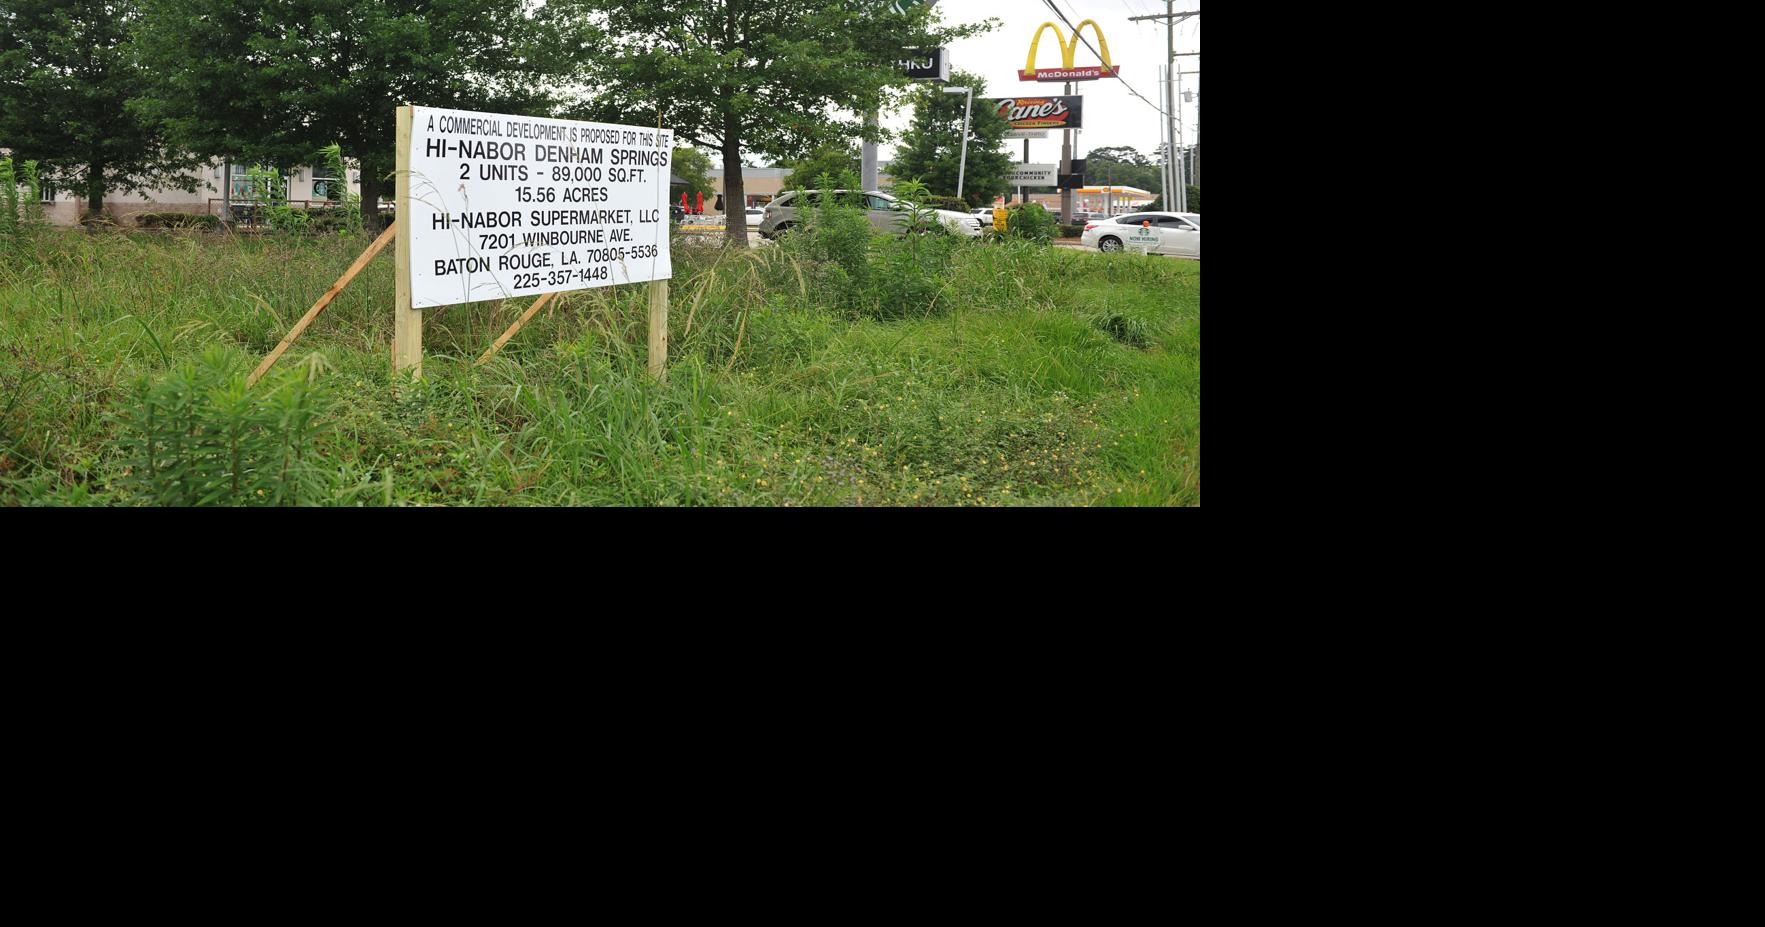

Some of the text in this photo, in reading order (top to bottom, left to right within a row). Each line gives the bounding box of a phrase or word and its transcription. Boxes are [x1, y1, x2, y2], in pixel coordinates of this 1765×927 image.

[1038, 70, 1099, 78] McDonald's
[993, 98, 1067, 120] Cane's
[428, 115, 669, 148] A COMMERCIAL DEVELOPMENT IS PROPOSED FOR THIS SITE
[426, 138, 668, 166] HI-NABOR DENHAM SPRINGS
[460, 164, 470, 180] 2
[480, 165, 528, 181] UNITS
[552, 167, 601, 184] 89,000
[609, 169, 646, 183] SQ.FT.
[515, 187, 608, 203] 15.56 ACRES
[432, 209, 659, 230] HI-NABOR SUPERMARKET, LLC
[480, 229, 633, 250] 7201 WINBOURNE AVE.
[435, 245, 658, 276] BATON ROUGE, LA. 70805-5536
[514, 267, 608, 289] 225-357-1448
